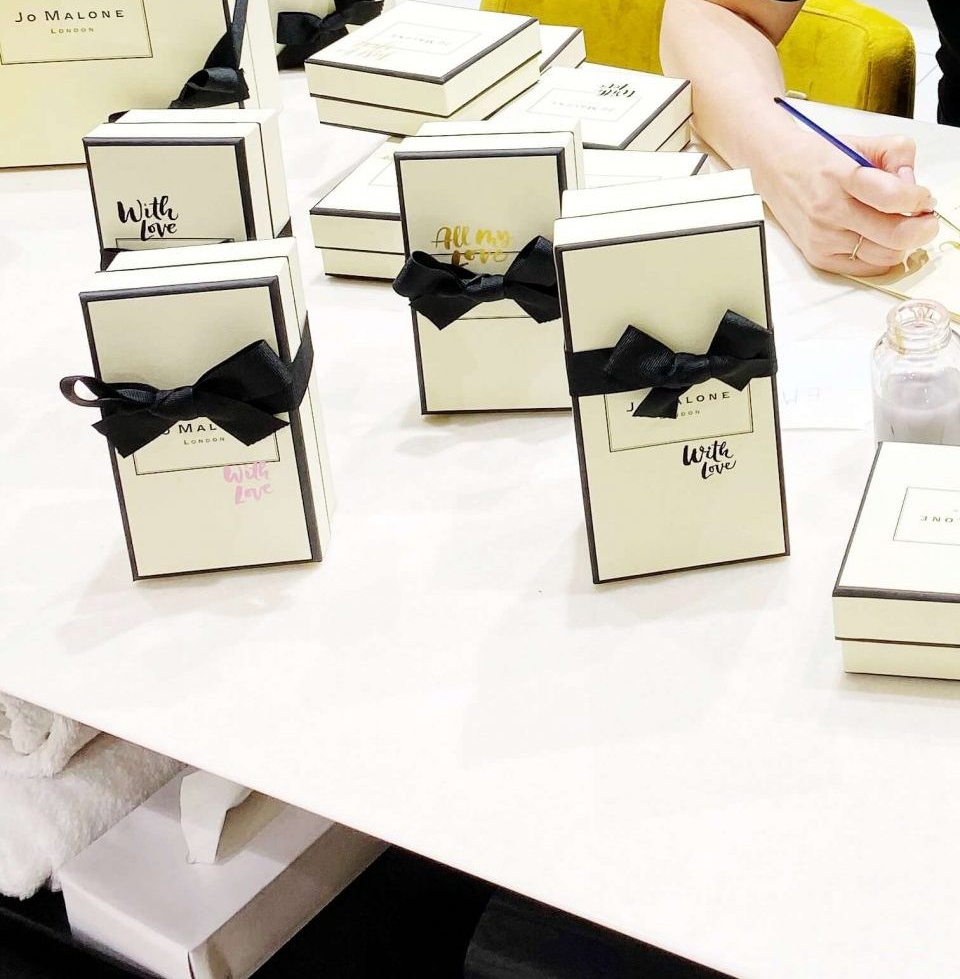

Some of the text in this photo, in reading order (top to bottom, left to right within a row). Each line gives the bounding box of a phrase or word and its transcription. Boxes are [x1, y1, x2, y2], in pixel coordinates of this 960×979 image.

[45, 9, 125, 22] MALONE
[117, 195, 179, 223] With
[140, 220, 178, 241] Love
[431, 226, 470, 250] All
[679, 391, 730, 405] LONE
[178, 423, 217, 434] MAL
[184, 437, 225, 445] LONDON
[682, 440, 734, 466] With
[223, 460, 270, 483] With
[701, 460, 737, 479] Love
[235, 484, 273, 505] Love
